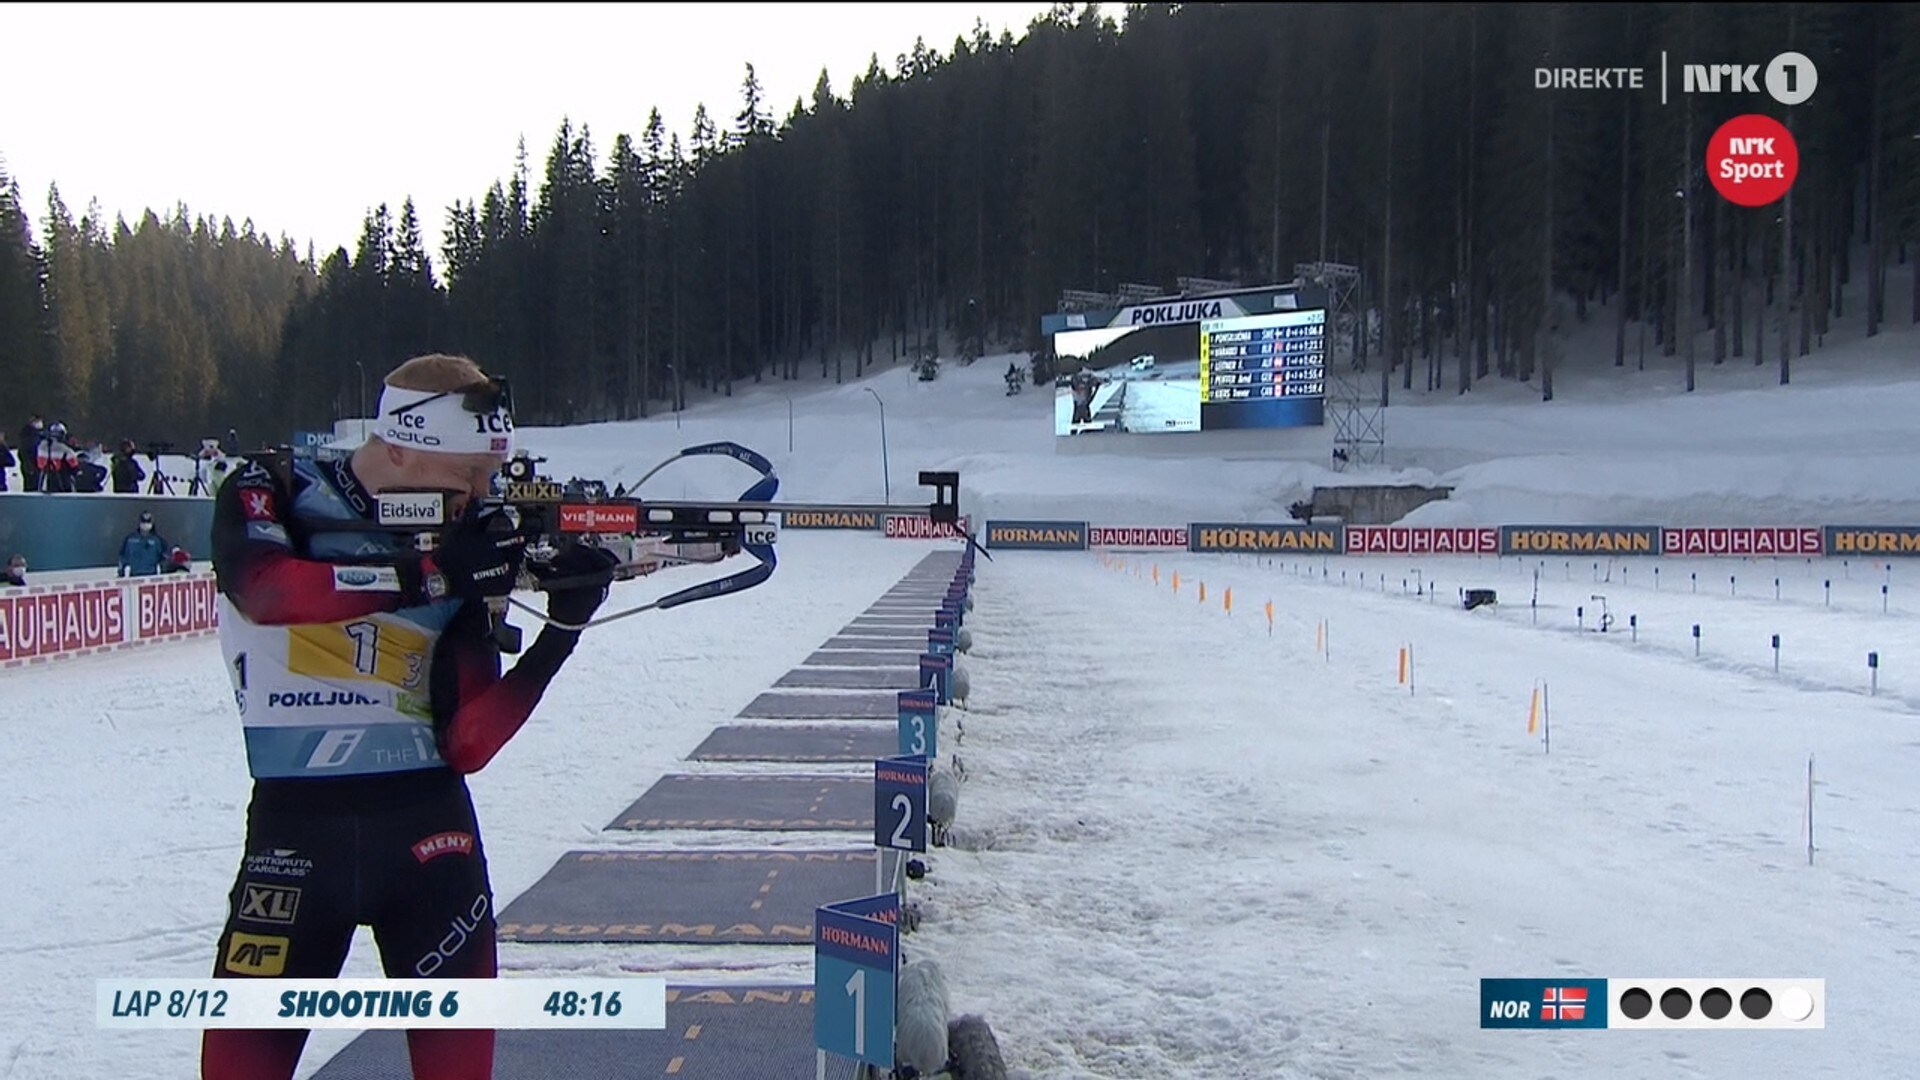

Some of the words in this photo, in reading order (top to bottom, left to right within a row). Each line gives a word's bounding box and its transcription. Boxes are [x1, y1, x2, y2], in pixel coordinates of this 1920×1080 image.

[1131, 301, 1222, 325] POKLJUKA
[381, 502, 435, 518] Eidsiva
[1090, 529, 1187, 545] BAUHAUS
[1201, 528, 1335, 549] HÖRMANN
[1350, 529, 1496, 549] BAUHAUS
[1511, 530, 1650, 550] HÖRMANN
[1665, 530, 1820, 549] BAUHAUS
[0, 596, 122, 649] AUHAUS
[345, 622, 378, 675] 1
[233, 651, 247, 690] 1
[402, 653, 423, 689] 3
[910, 715, 925, 755] 3
[891, 795, 912, 848] 2
[419, 836, 469, 855] MENY
[866, 909, 897, 922] ANN
[416, 894, 488, 976] odlo
[845, 969, 865, 1055] 1
